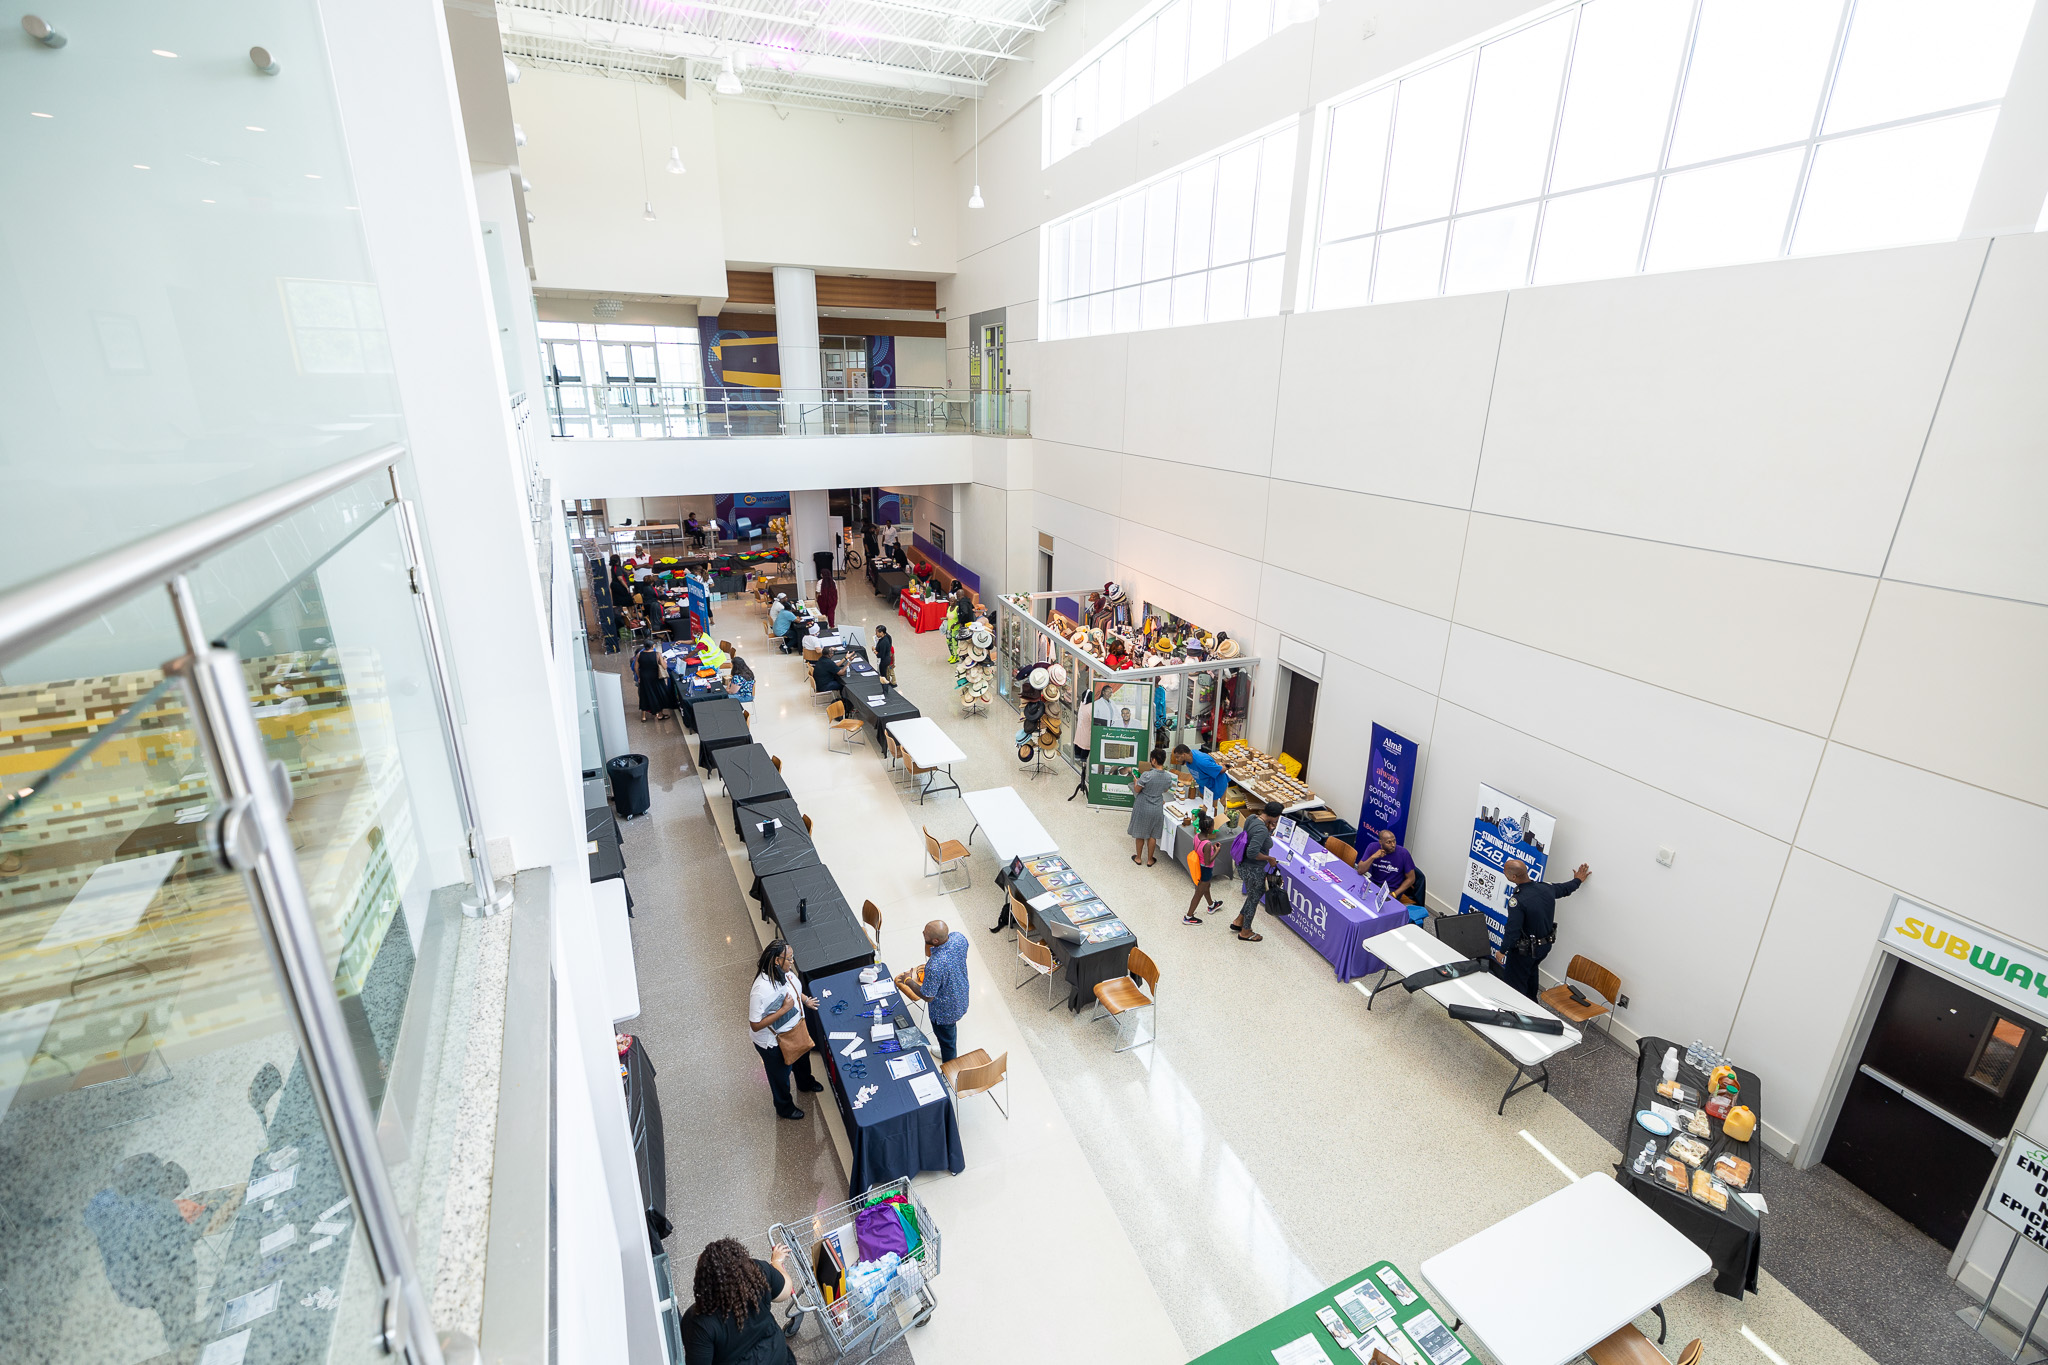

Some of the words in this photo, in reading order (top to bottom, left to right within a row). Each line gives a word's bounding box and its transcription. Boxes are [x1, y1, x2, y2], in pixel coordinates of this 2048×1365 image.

[1376, 767, 1400, 785] always
[1384, 758, 1397, 772] You
[1377, 777, 1396, 794] have
[1369, 785, 1401, 809] someone
[1369, 796, 1383, 808] you
[1384, 804, 1398, 817] can
[1375, 809, 1389, 823] call.
[1482, 830, 1503, 850] STARTING
[1503, 842, 1517, 856] BASE
[1516, 849, 1536, 866] SALARY
[1474, 838, 1540, 882] $48,0
[1287, 876, 1327, 931] lma
[1297, 912, 1326, 940] VIOLENCE
